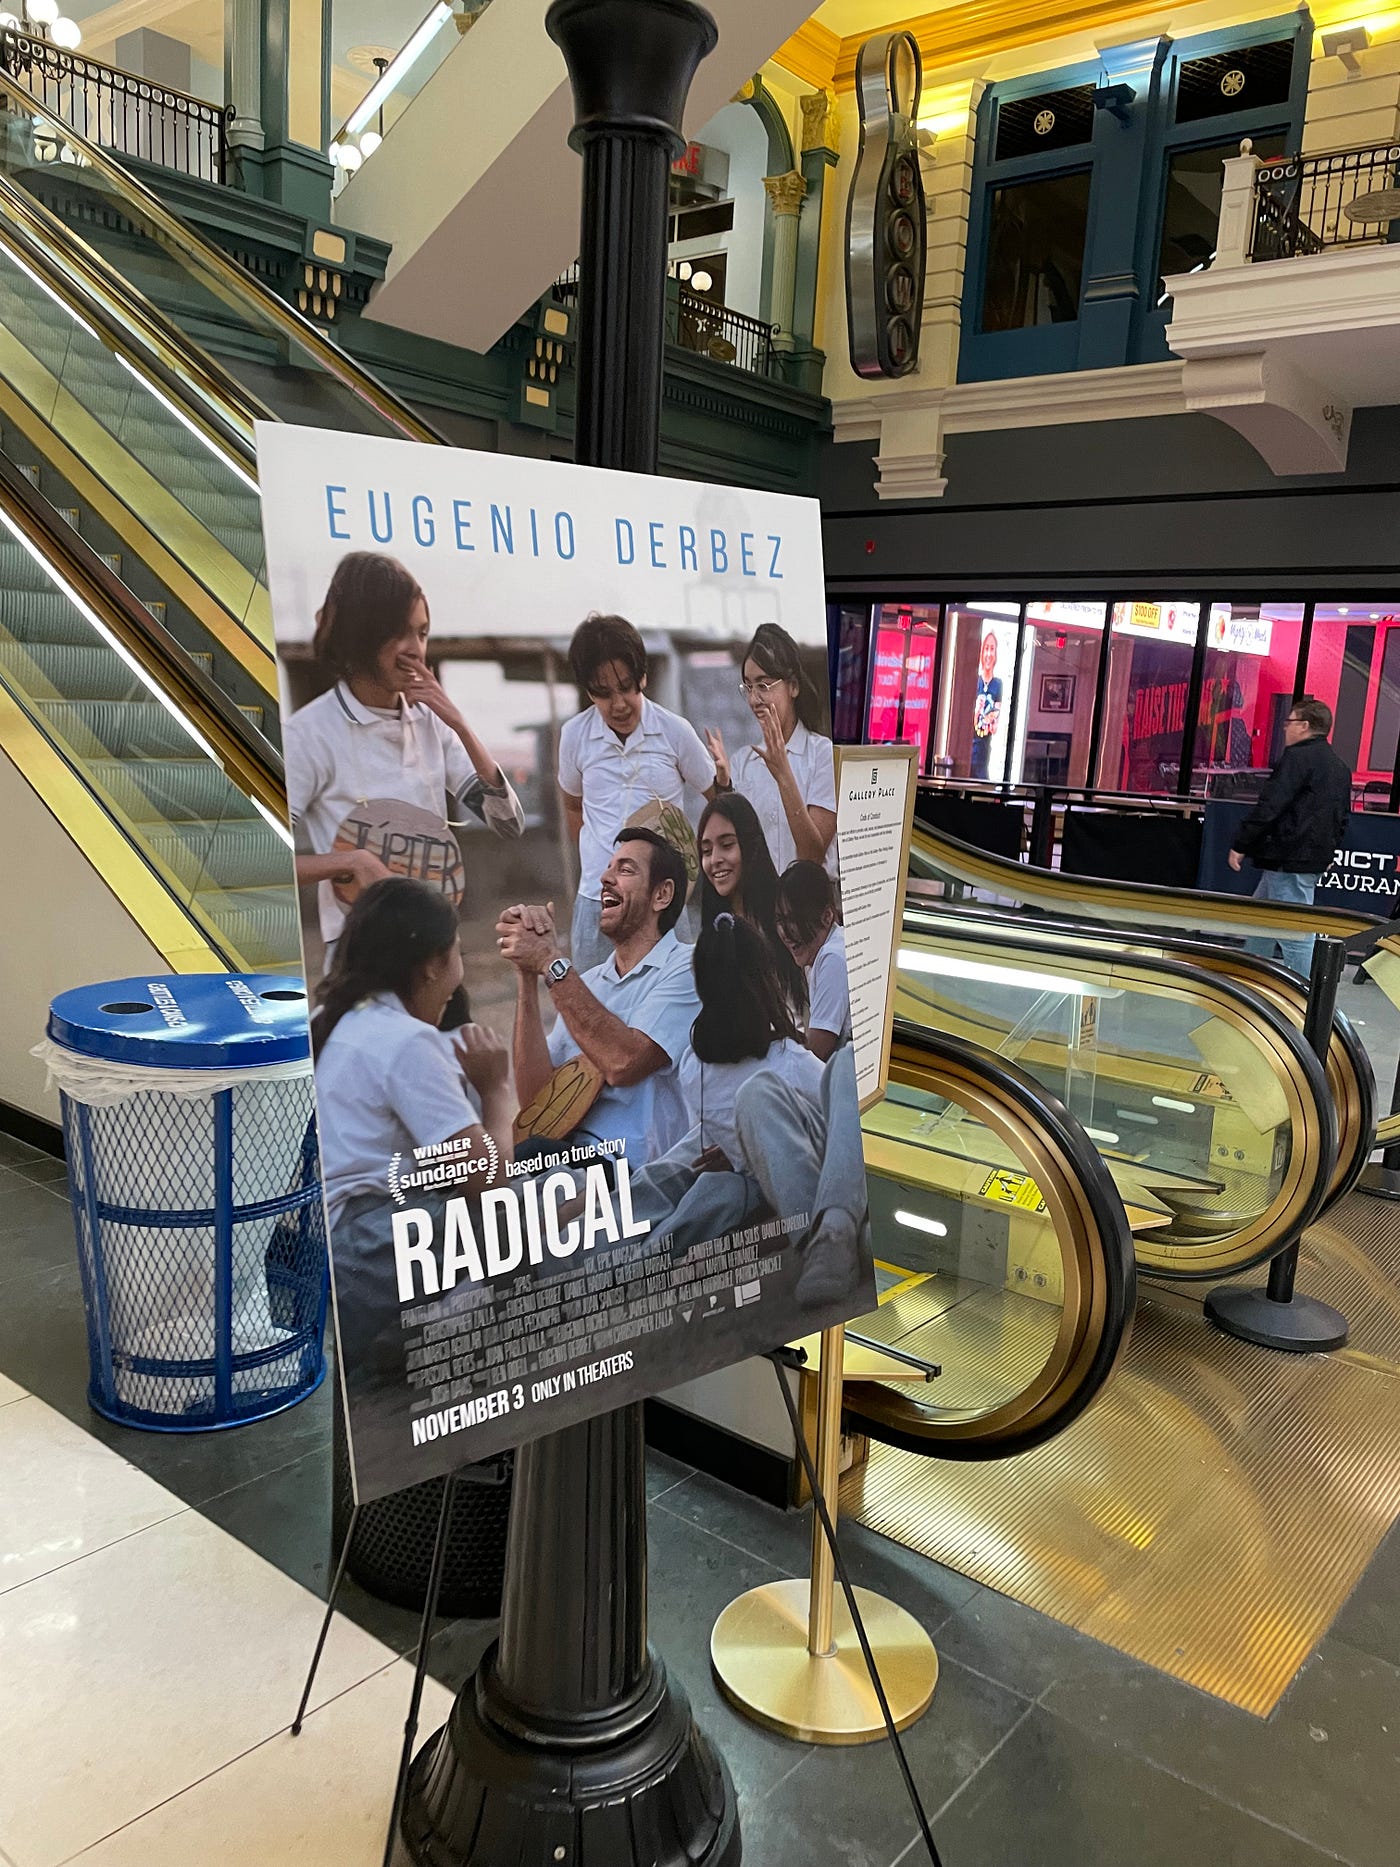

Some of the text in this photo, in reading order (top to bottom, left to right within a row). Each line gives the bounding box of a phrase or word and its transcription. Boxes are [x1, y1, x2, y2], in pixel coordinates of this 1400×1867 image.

[325, 485, 784, 579] EUGENIO DERBEZ
[1133, 685, 1167, 740] RAISE
[849, 787, 895, 802] GALLERY PLACE
[400, 1155, 489, 1190] sundance
[413, 1137, 472, 1160] WINNER
[505, 1137, 626, 1178] based on a true story
[391, 1157, 651, 1303] RADICAL
[411, 1350, 634, 1447] NOVEMBER 3 ONLY IN THEATERS
